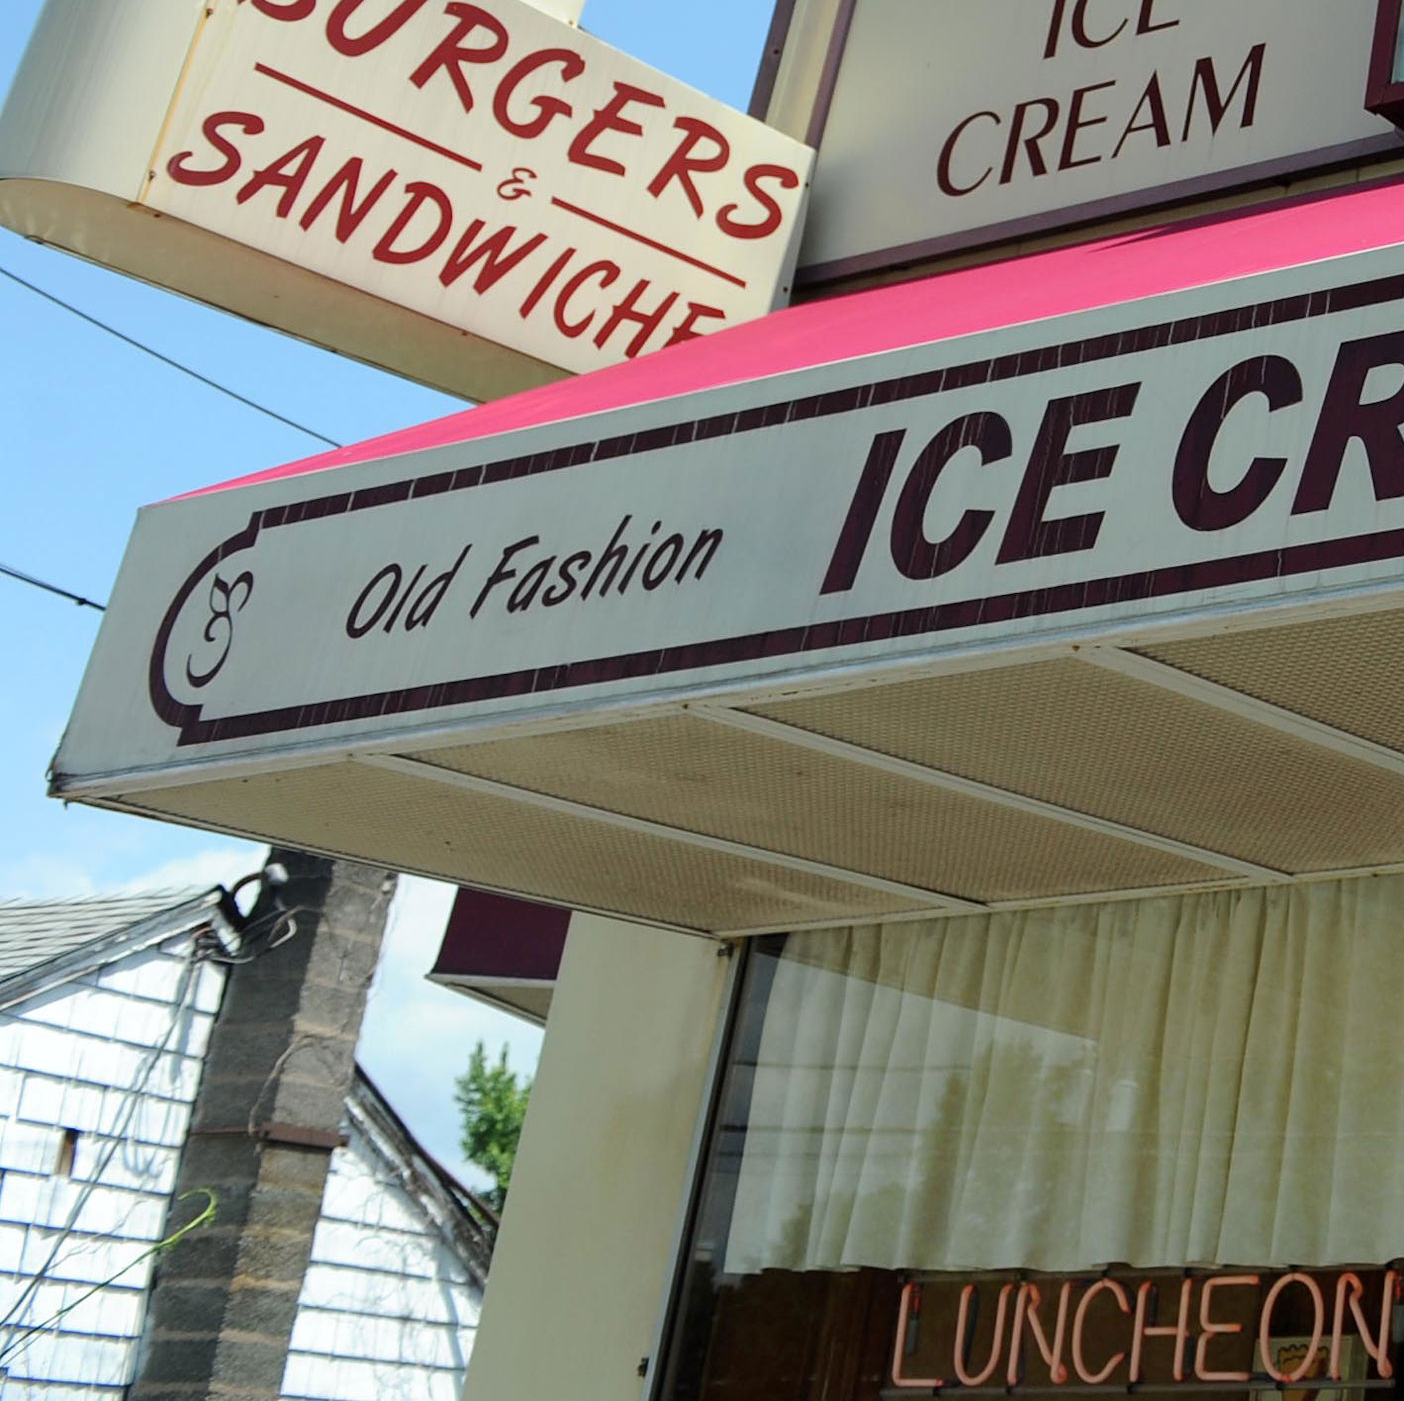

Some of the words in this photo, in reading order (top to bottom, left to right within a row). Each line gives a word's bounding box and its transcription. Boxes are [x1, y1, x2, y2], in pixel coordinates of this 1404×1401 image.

[936, 42, 1266, 196] CREAM
[497, 167, 537, 201] &
[819, 382, 1143, 593] ICE
[346, 544, 472, 639] Old
[469, 514, 724, 620] Fashion
[892, 1272, 1397, 1386] LUNCHEON
